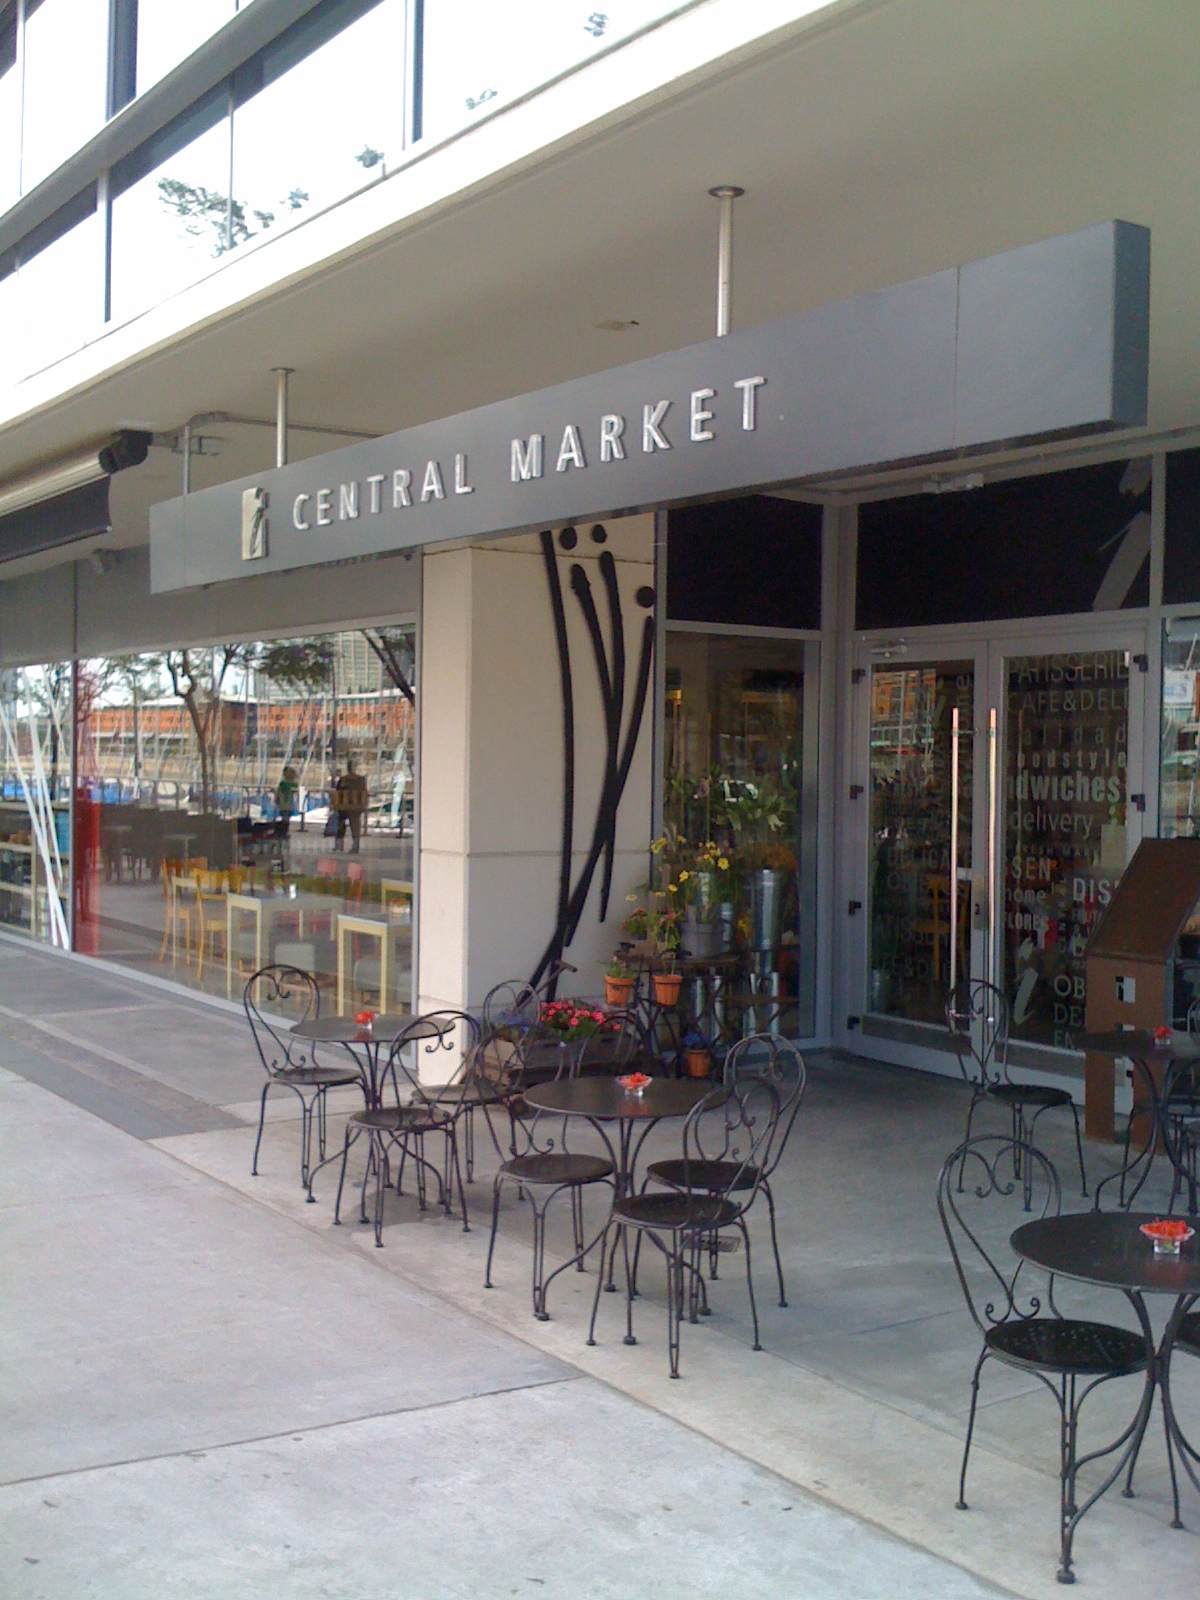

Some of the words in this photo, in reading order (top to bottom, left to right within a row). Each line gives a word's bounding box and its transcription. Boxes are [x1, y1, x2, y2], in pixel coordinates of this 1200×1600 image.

[292, 453, 473, 531] CENTRAL
[510, 375, 767, 483] MARKET
[1009, 805, 1094, 840] delivery
